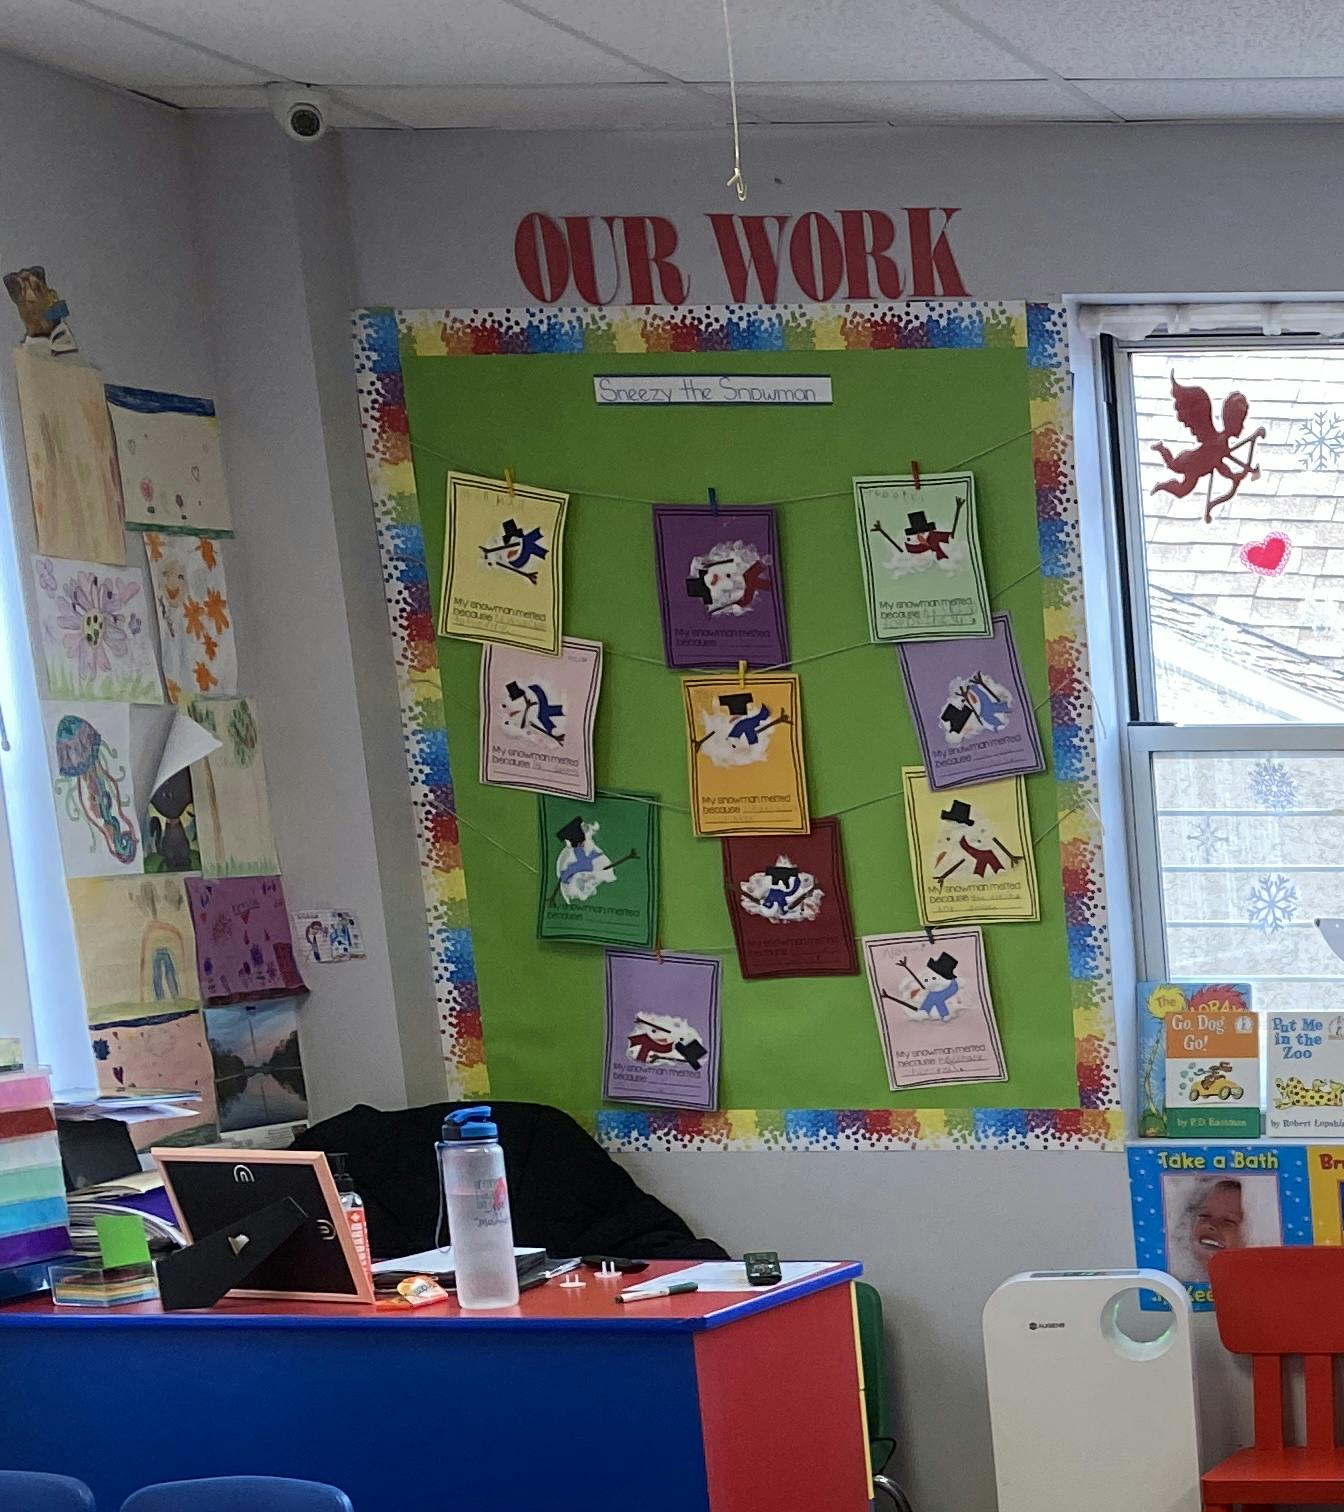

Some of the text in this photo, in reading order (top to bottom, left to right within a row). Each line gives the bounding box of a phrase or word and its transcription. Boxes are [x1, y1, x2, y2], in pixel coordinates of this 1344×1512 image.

[514, 207, 972, 305] OUR WORK
[600, 376, 816, 403] Sneezy the Snowman
[1272, 1018, 1323, 1032] Put Me
[1184, 1035, 1209, 1051] Go!
[1275, 1033, 1323, 1046] in the
[1283, 1046, 1313, 1060] Zoo
[1283, 1119, 1312, 1128] Robert
[1158, 1152, 1278, 1170] Take a Bath
